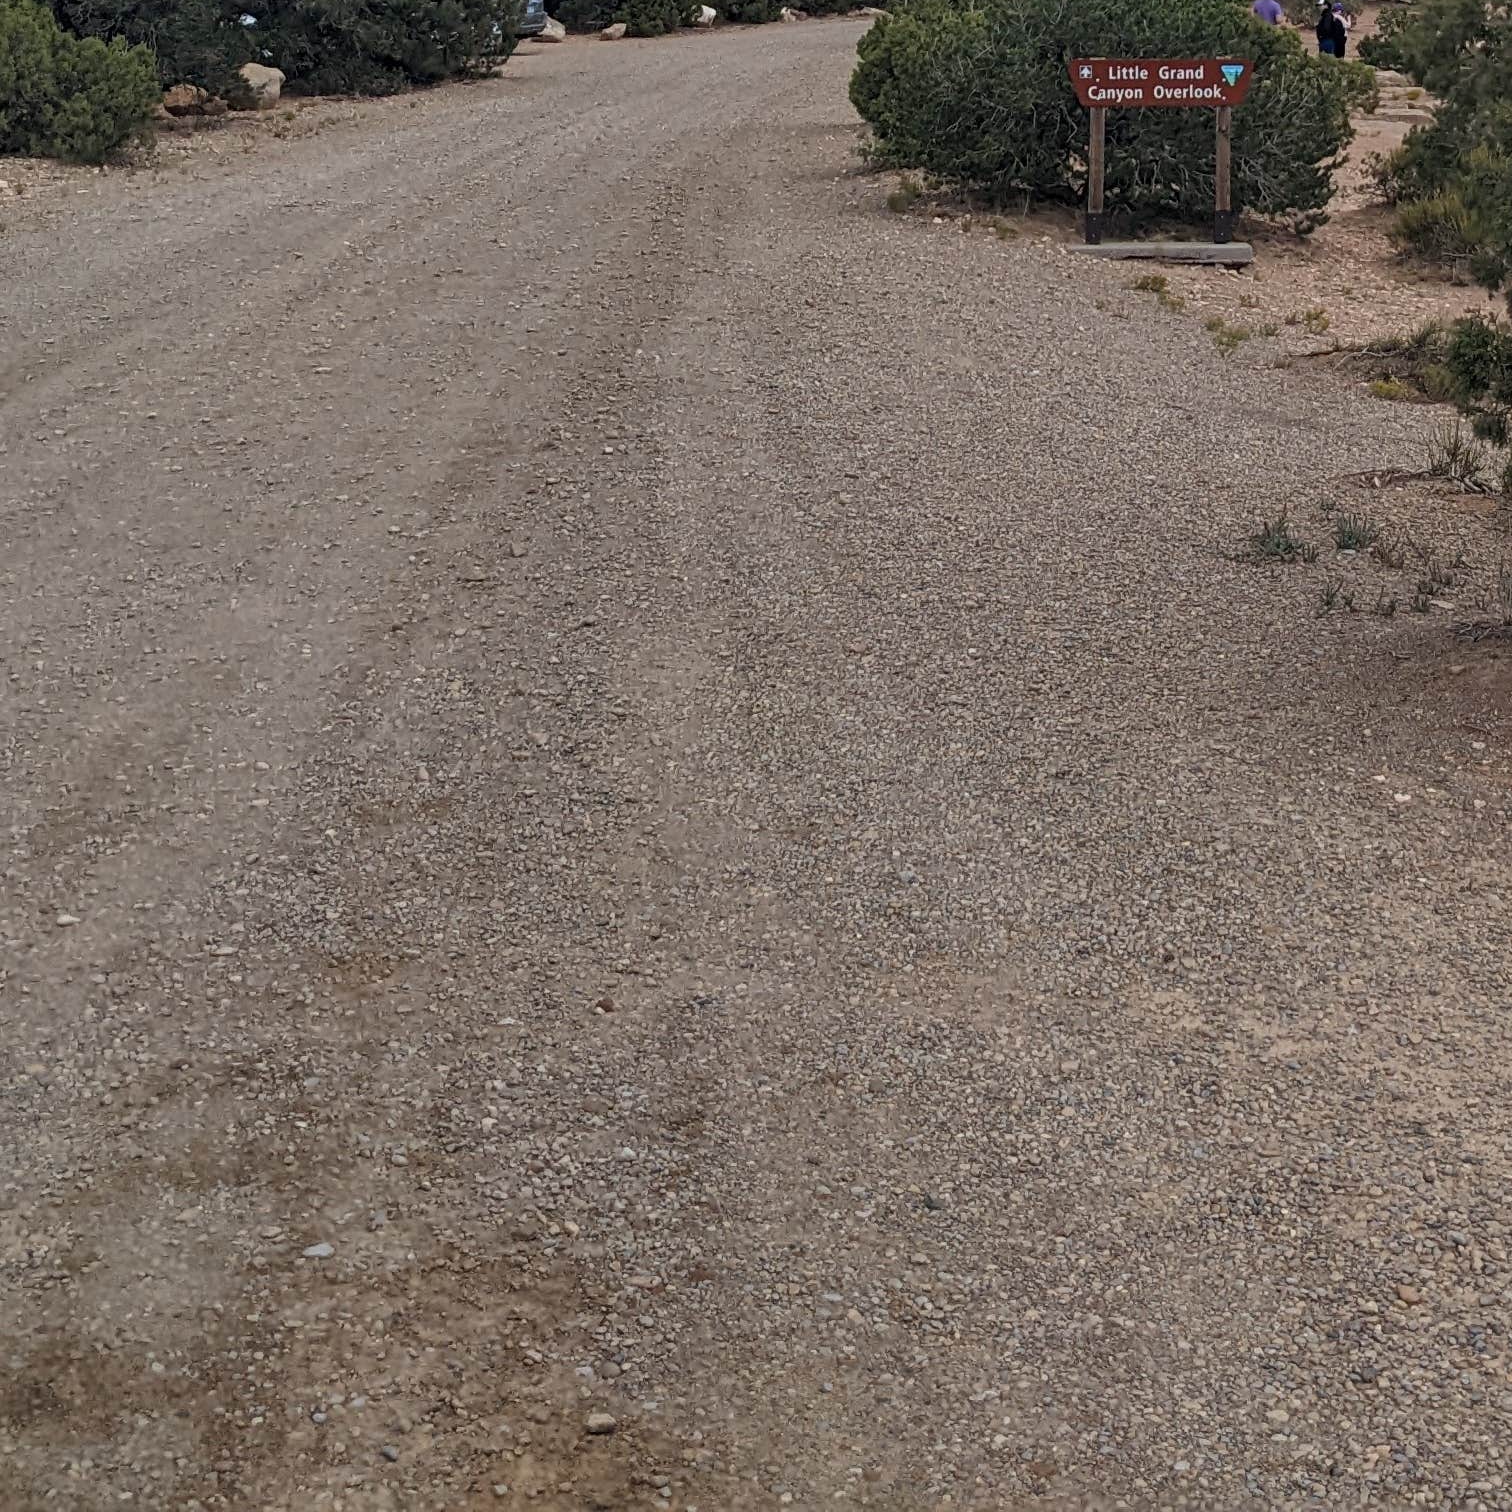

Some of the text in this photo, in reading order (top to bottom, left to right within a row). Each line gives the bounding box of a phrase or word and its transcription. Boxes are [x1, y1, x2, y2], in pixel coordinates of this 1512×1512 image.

[1108, 65, 1204, 80] Little Grand
[1088, 84, 1221, 103] Canyon Overlook
